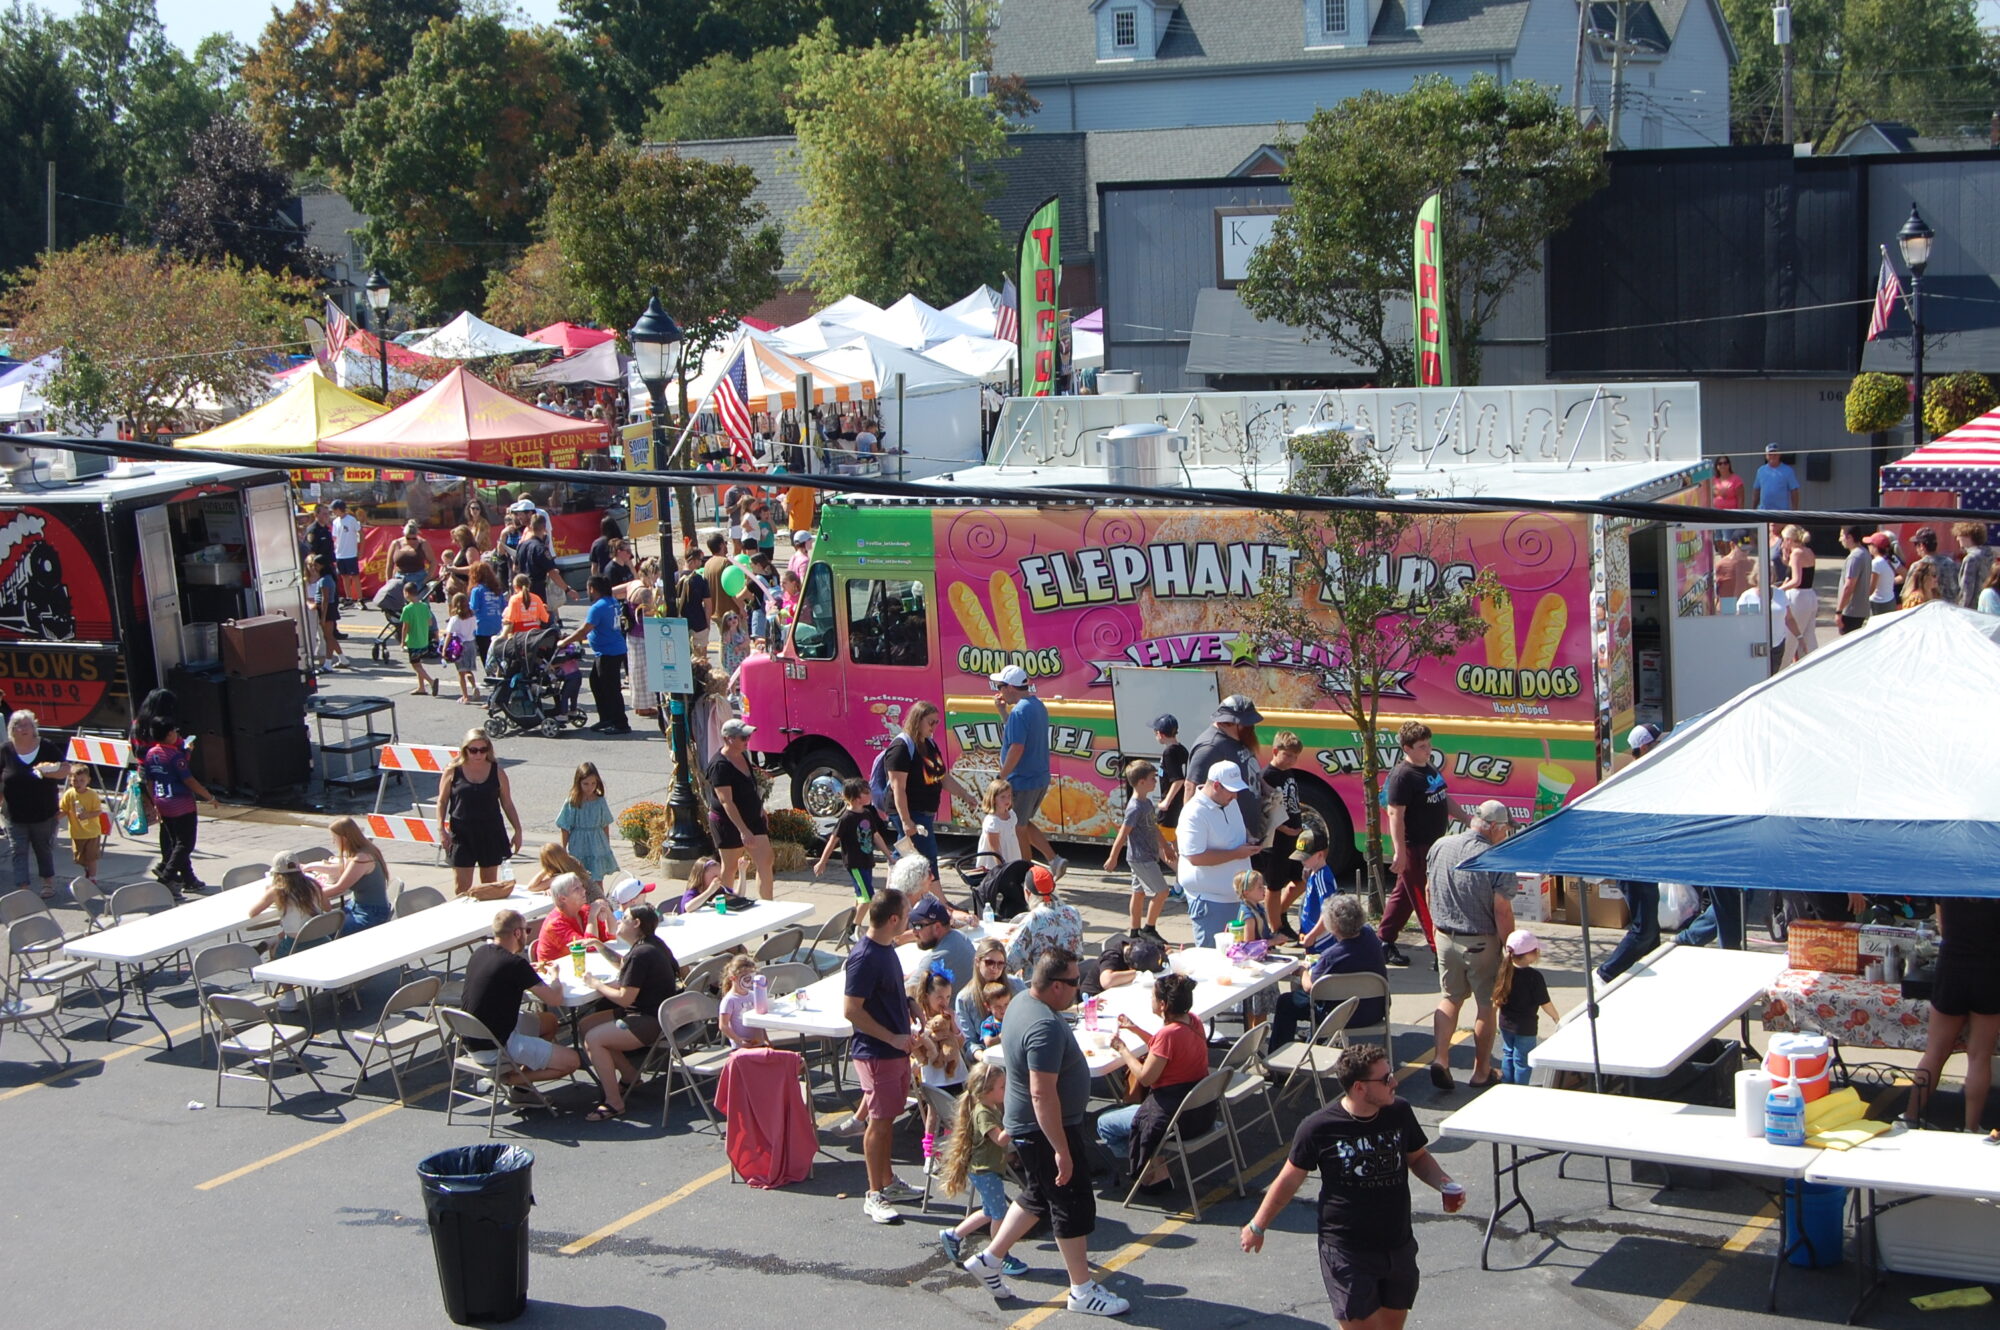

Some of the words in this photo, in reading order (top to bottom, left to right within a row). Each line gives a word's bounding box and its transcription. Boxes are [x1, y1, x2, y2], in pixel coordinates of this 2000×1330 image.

[1031, 227, 1056, 396] TACO
[1420, 219, 1443, 387] TACO
[1819, 391, 1843, 402] 106
[500, 438, 545, 456] KETTLE
[551, 433, 584, 447] CORN
[1018, 540, 1302, 613] ELEPHANT
[958, 645, 1007, 674] CORN
[1011, 646, 1062, 677] DOGS
[1135, 635, 1221, 667] FIVE
[1457, 663, 1515, 697] CORN
[1520, 666, 1580, 698] DOGS
[1492, 702, 1516, 714] Hand
[1517, 703, 1549, 715] Dipped
[954, 722, 1093, 759] FUEL
[1454, 752, 1513, 785] ICE
